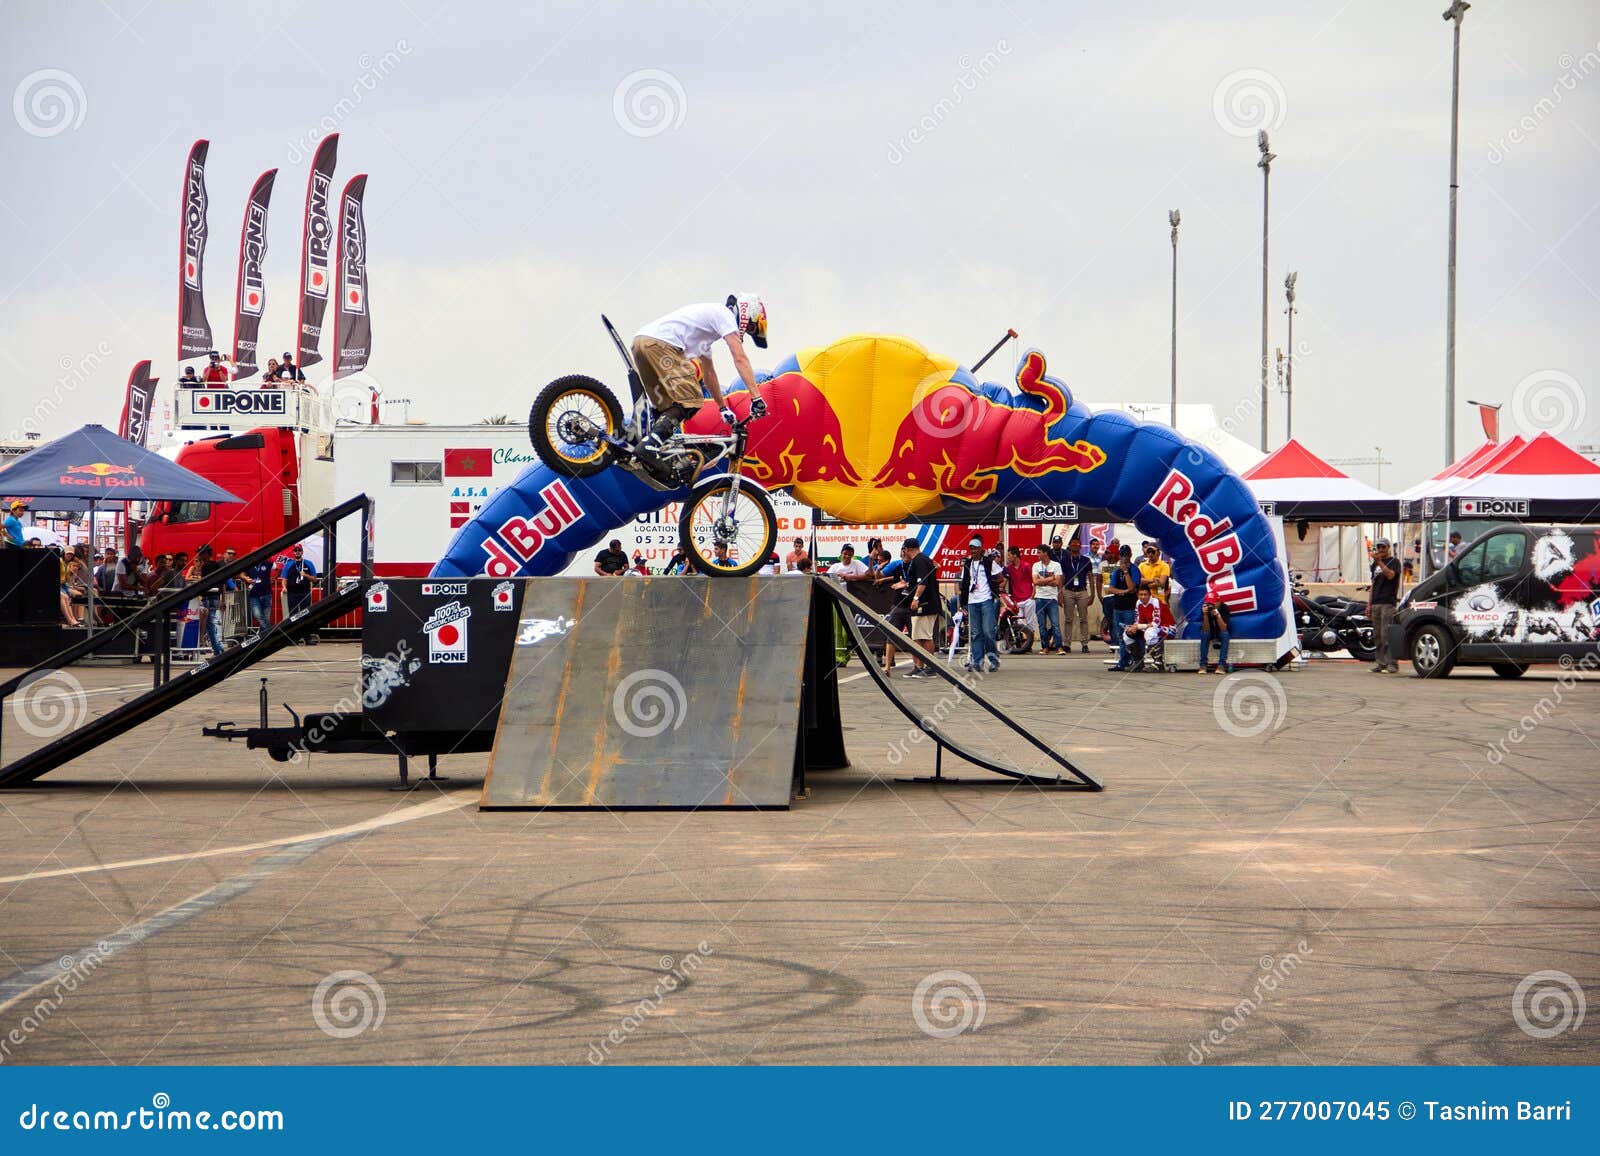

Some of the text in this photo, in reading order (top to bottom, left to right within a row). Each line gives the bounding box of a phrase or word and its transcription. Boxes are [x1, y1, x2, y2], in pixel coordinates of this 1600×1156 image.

[309, 174, 328, 268] IPONE
[246, 204, 265, 288] IPONE
[346, 199, 361, 286] IPONE
[214, 393, 282, 411] IPONE
[59, 476, 145, 487] Red Bull
[1031, 503, 1076, 517] IPONE
[1476, 501, 1526, 513] IPONE
[634, 525, 677, 533] LOCATION
[635, 536, 652, 544] 05
[658, 536, 675, 544] 22
[941, 548, 968, 556] Race
[431, 584, 466, 594] IPONE
[435, 602, 460, 620] 100%
[1463, 613, 1500, 621] KYMCO
[432, 652, 466, 661] IPONE
